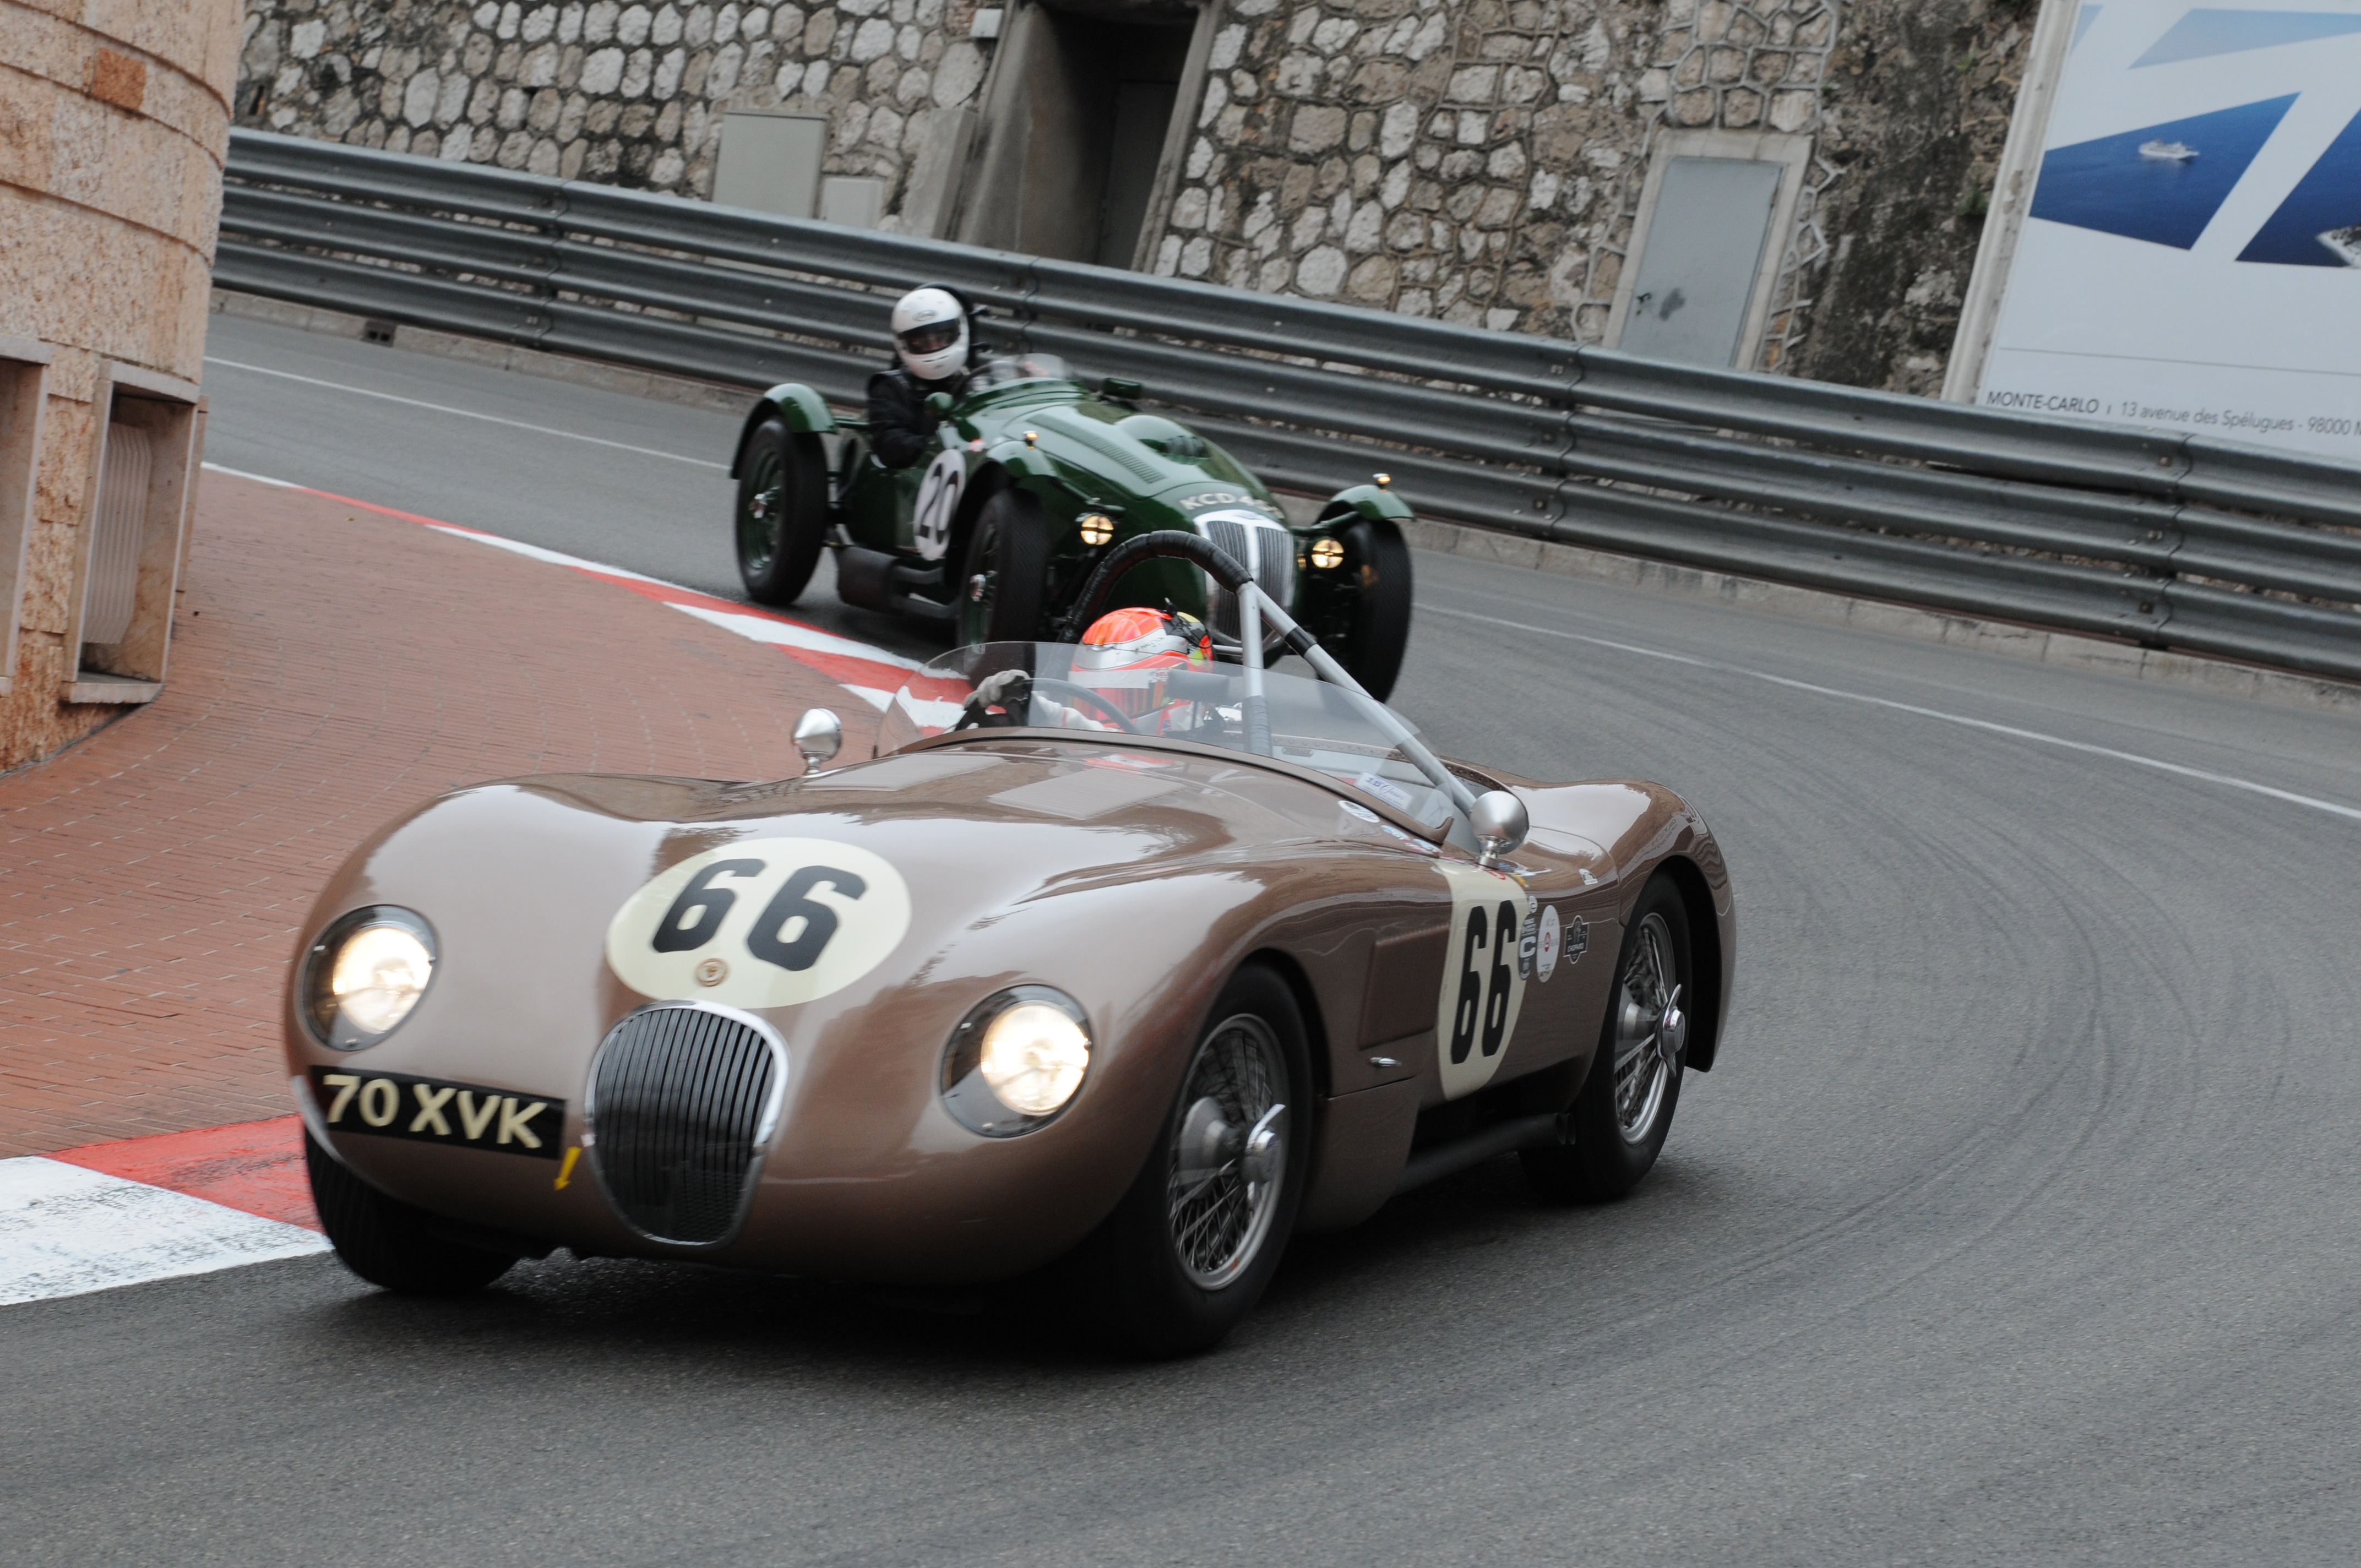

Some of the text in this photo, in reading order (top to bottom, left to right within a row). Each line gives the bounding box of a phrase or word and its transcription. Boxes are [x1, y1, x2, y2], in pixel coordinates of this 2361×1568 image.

[1986, 390, 2100, 414] MONTE-CARLO
[2121, 401, 2138, 417] 13
[2140, 407, 2190, 422] avenue
[2193, 407, 2218, 425] des
[2221, 410, 2294, 433] Spélugues
[2308, 416, 2352, 435] 98000
[919, 462, 959, 545] 20
[1179, 492, 1237, 510] KCD
[651, 858, 867, 972] 66
[1450, 900, 1517, 1065] 66
[323, 1074, 548, 1149] 70 XVK
